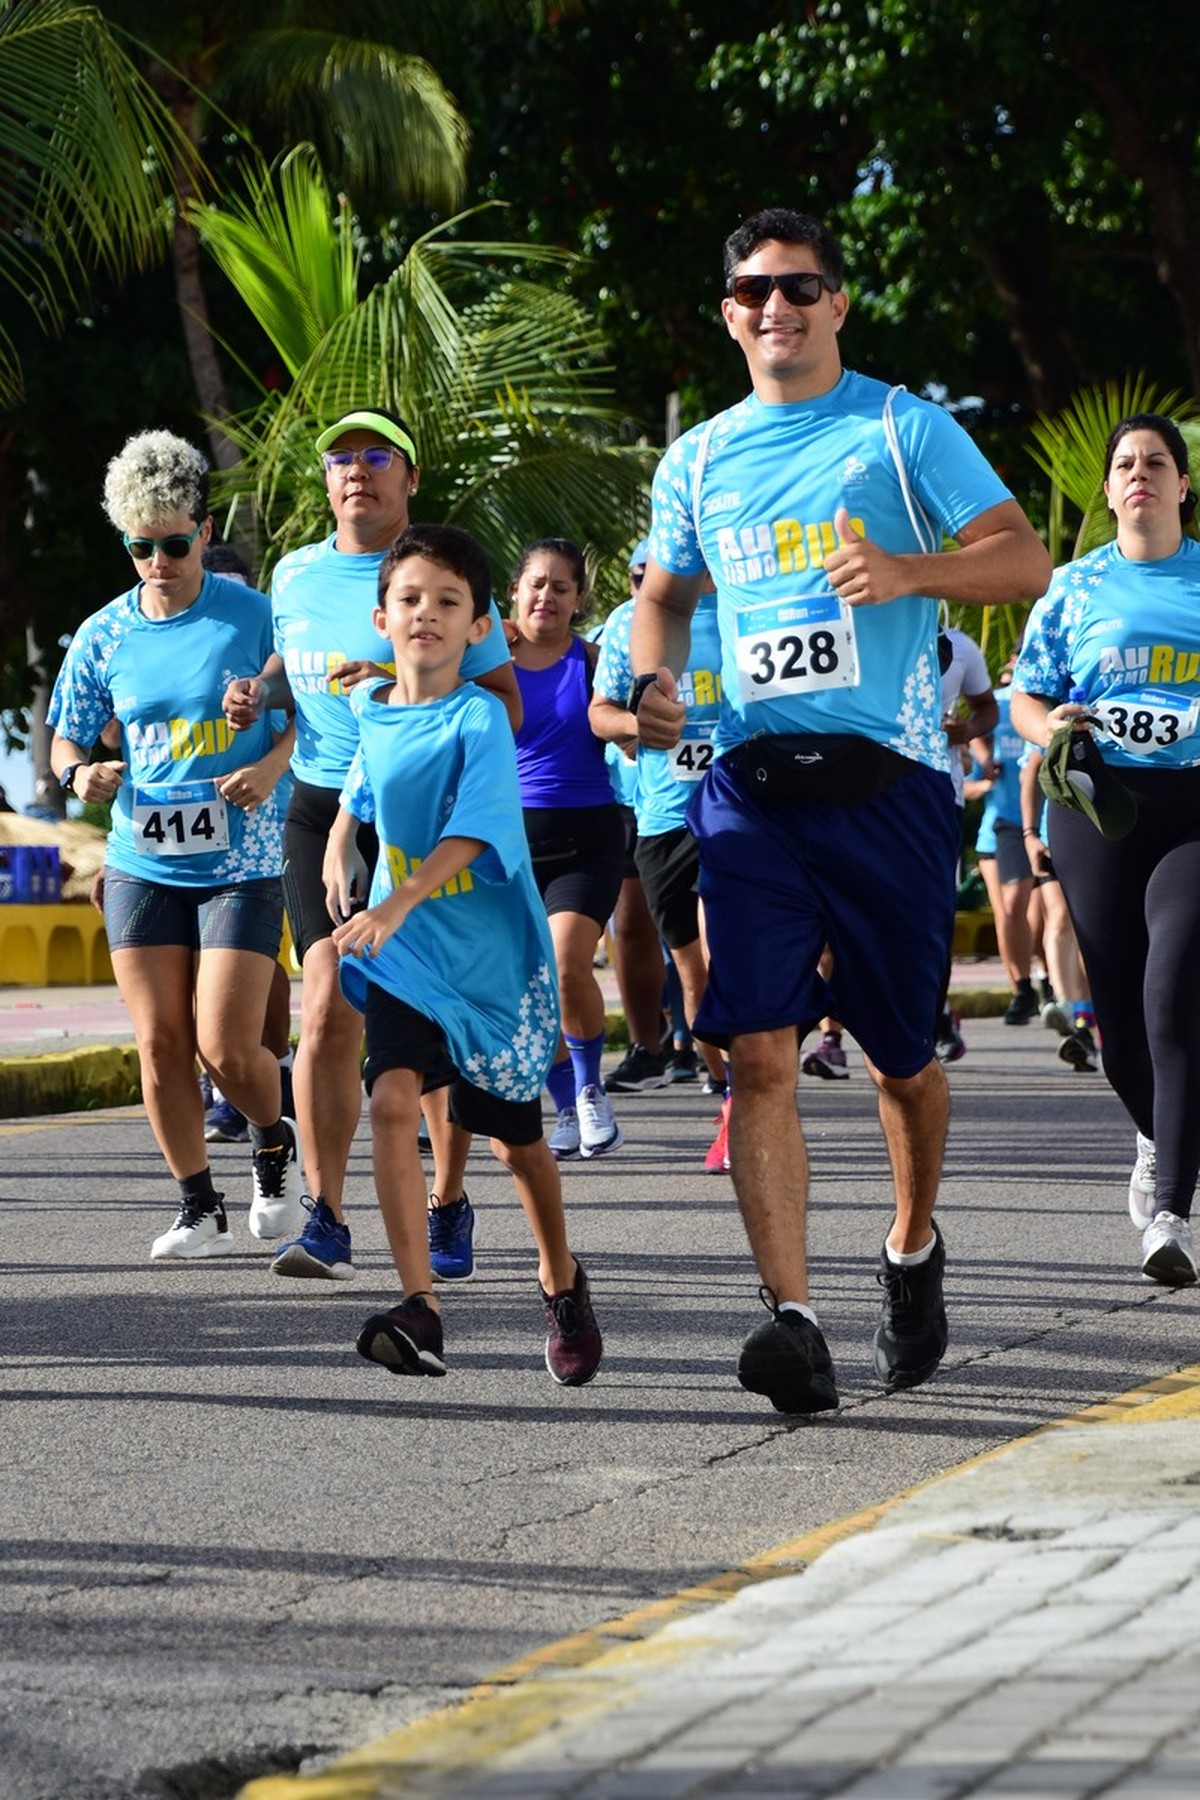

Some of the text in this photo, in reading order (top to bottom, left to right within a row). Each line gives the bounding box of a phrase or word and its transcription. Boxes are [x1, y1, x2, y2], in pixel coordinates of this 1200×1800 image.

[750, 630, 839, 685] 328
[1099, 645, 1200, 685] AuRu
[1107, 707, 1179, 746] 383
[676, 744, 715, 771] 42
[142, 808, 215, 844] 414
